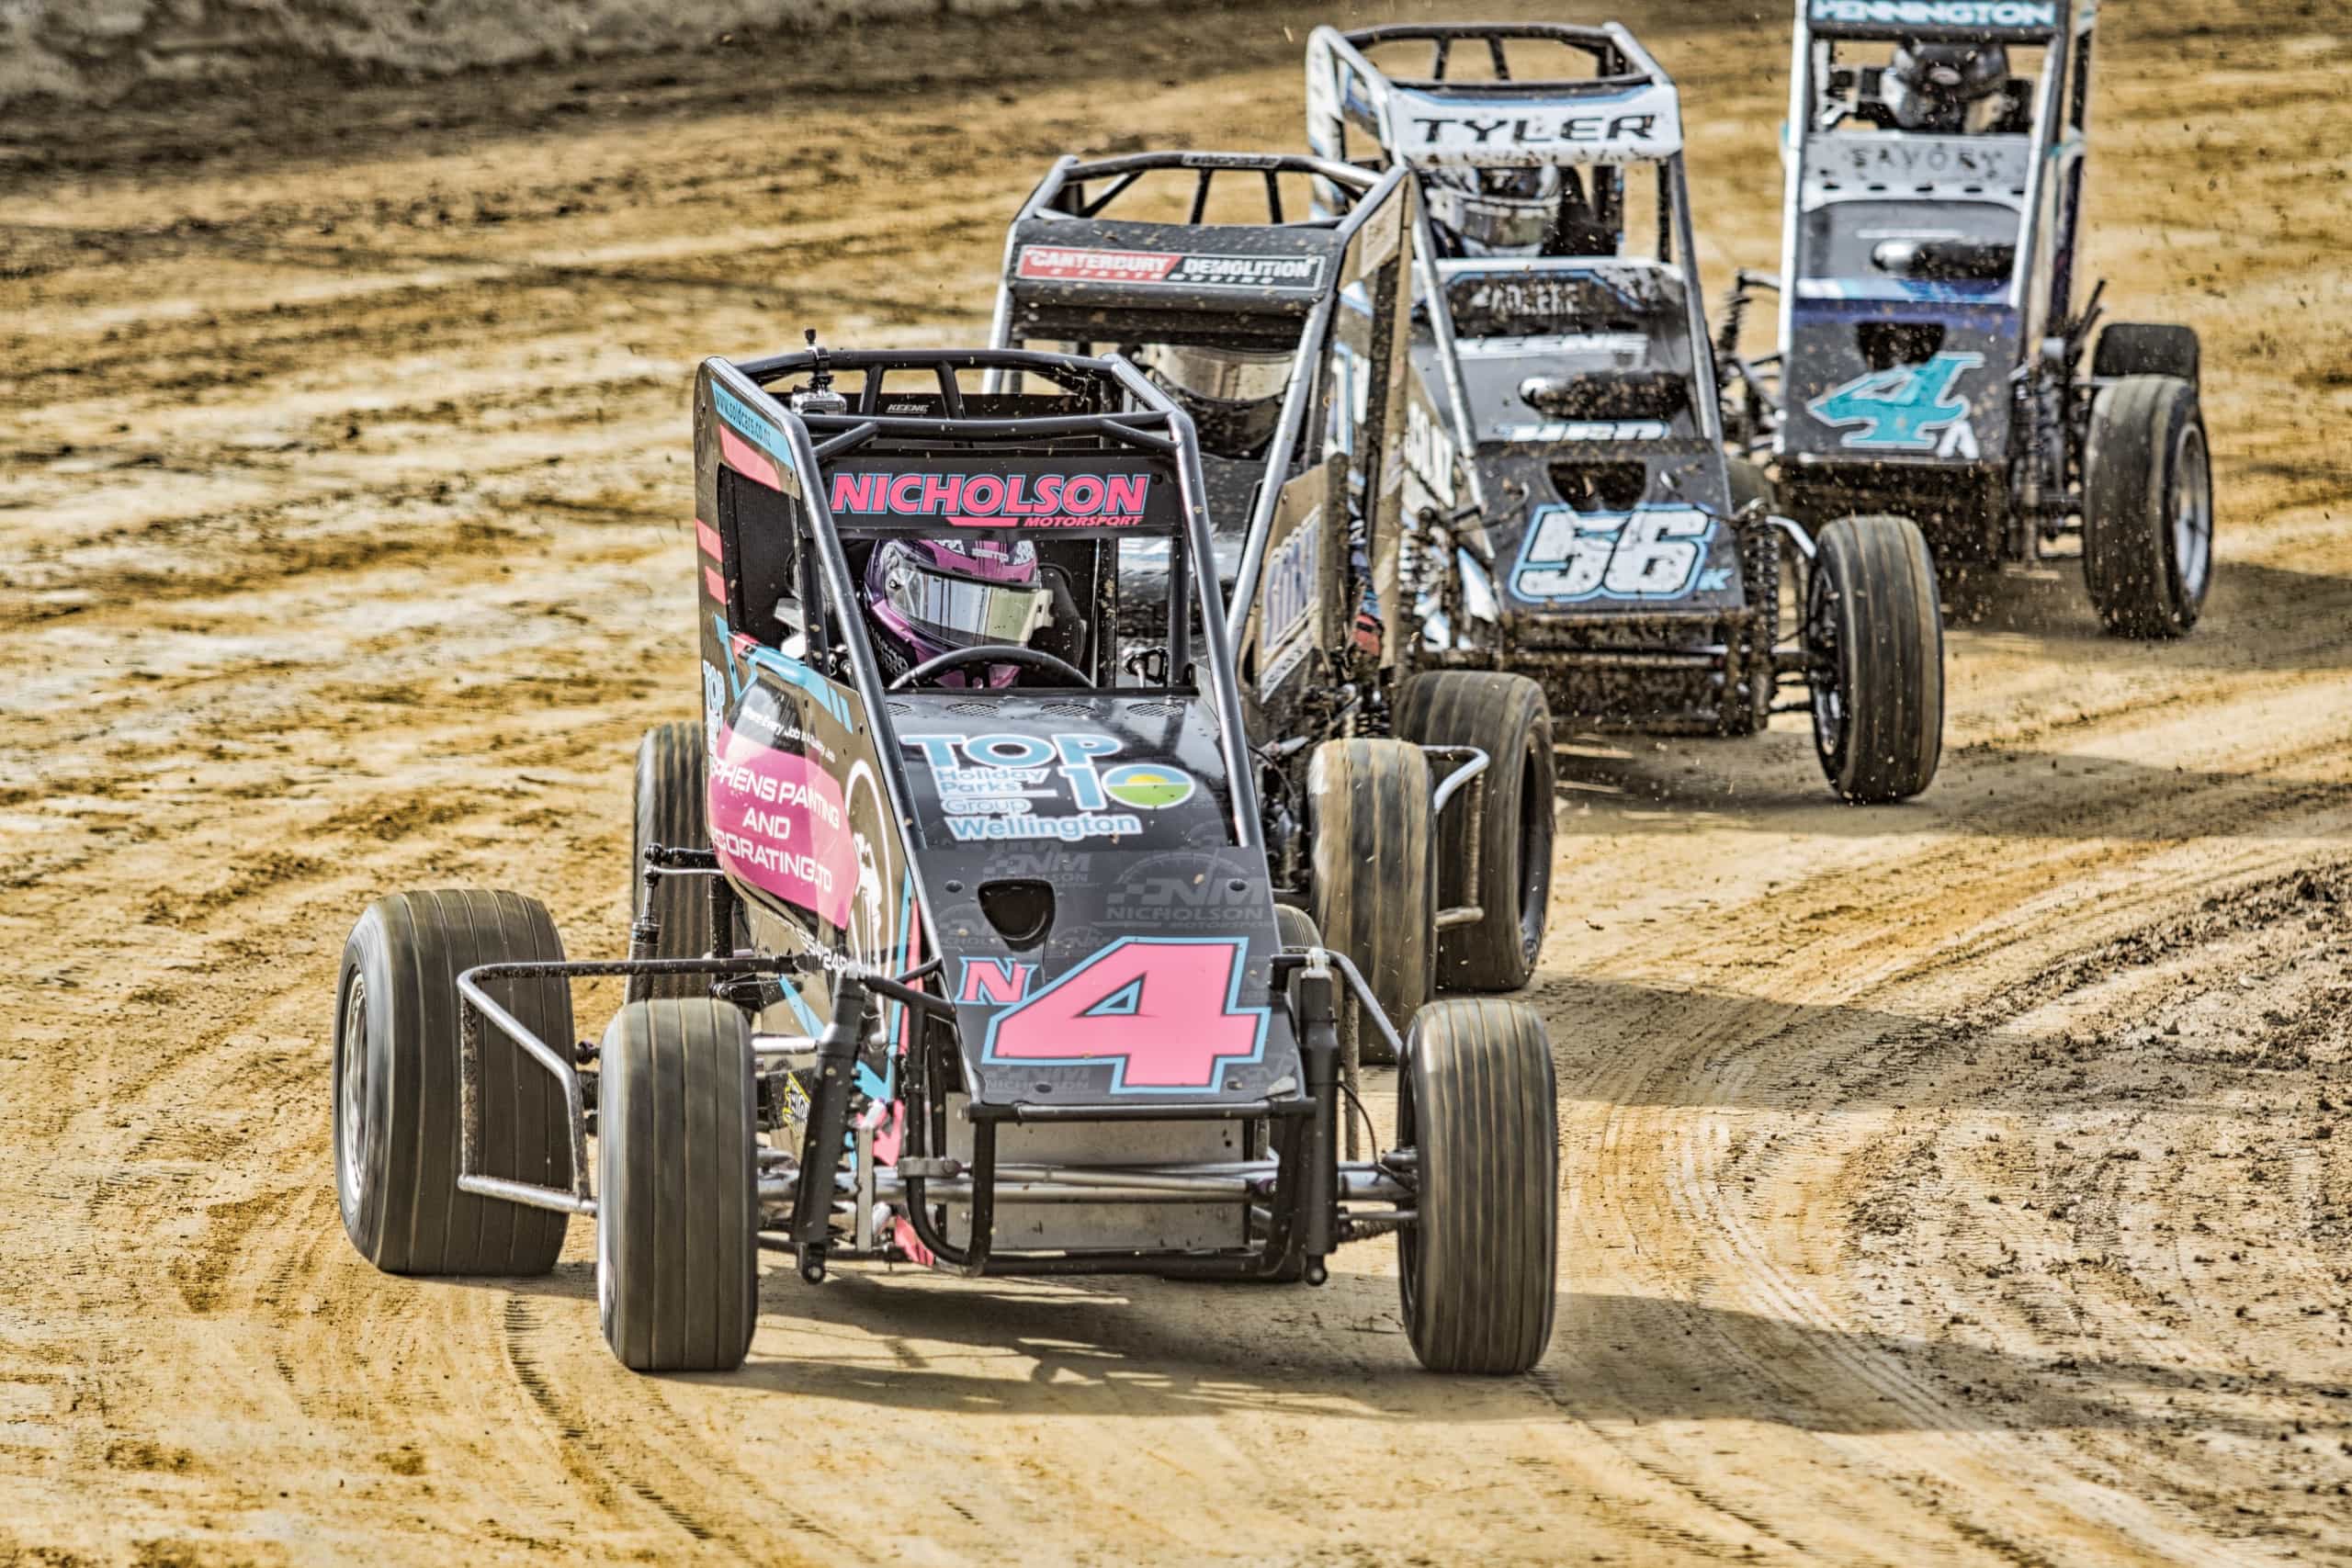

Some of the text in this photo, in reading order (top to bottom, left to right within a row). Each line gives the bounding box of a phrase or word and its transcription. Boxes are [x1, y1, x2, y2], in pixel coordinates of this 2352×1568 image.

[1413, 114, 1657, 143] TYLER
[1182, 257, 1311, 277] DEMOLITION
[886, 403, 930, 413] KEENE
[1806, 351, 1986, 448] 4
[831, 472, 1151, 516] NICHOLSON
[1023, 515, 1145, 527] MOTORSPORT
[1509, 502, 1720, 604] 56
[899, 733, 1124, 768] TOP
[935, 768, 1049, 784] Holiday
[939, 780, 1023, 794] Parks
[942, 798, 1032, 814] Group
[741, 807, 791, 840] AND
[946, 812, 1142, 840] Wellington
[1106, 907, 1265, 919] NICHOLSON
[955, 955, 1040, 1005] N
[980, 935, 1272, 1095] 4
